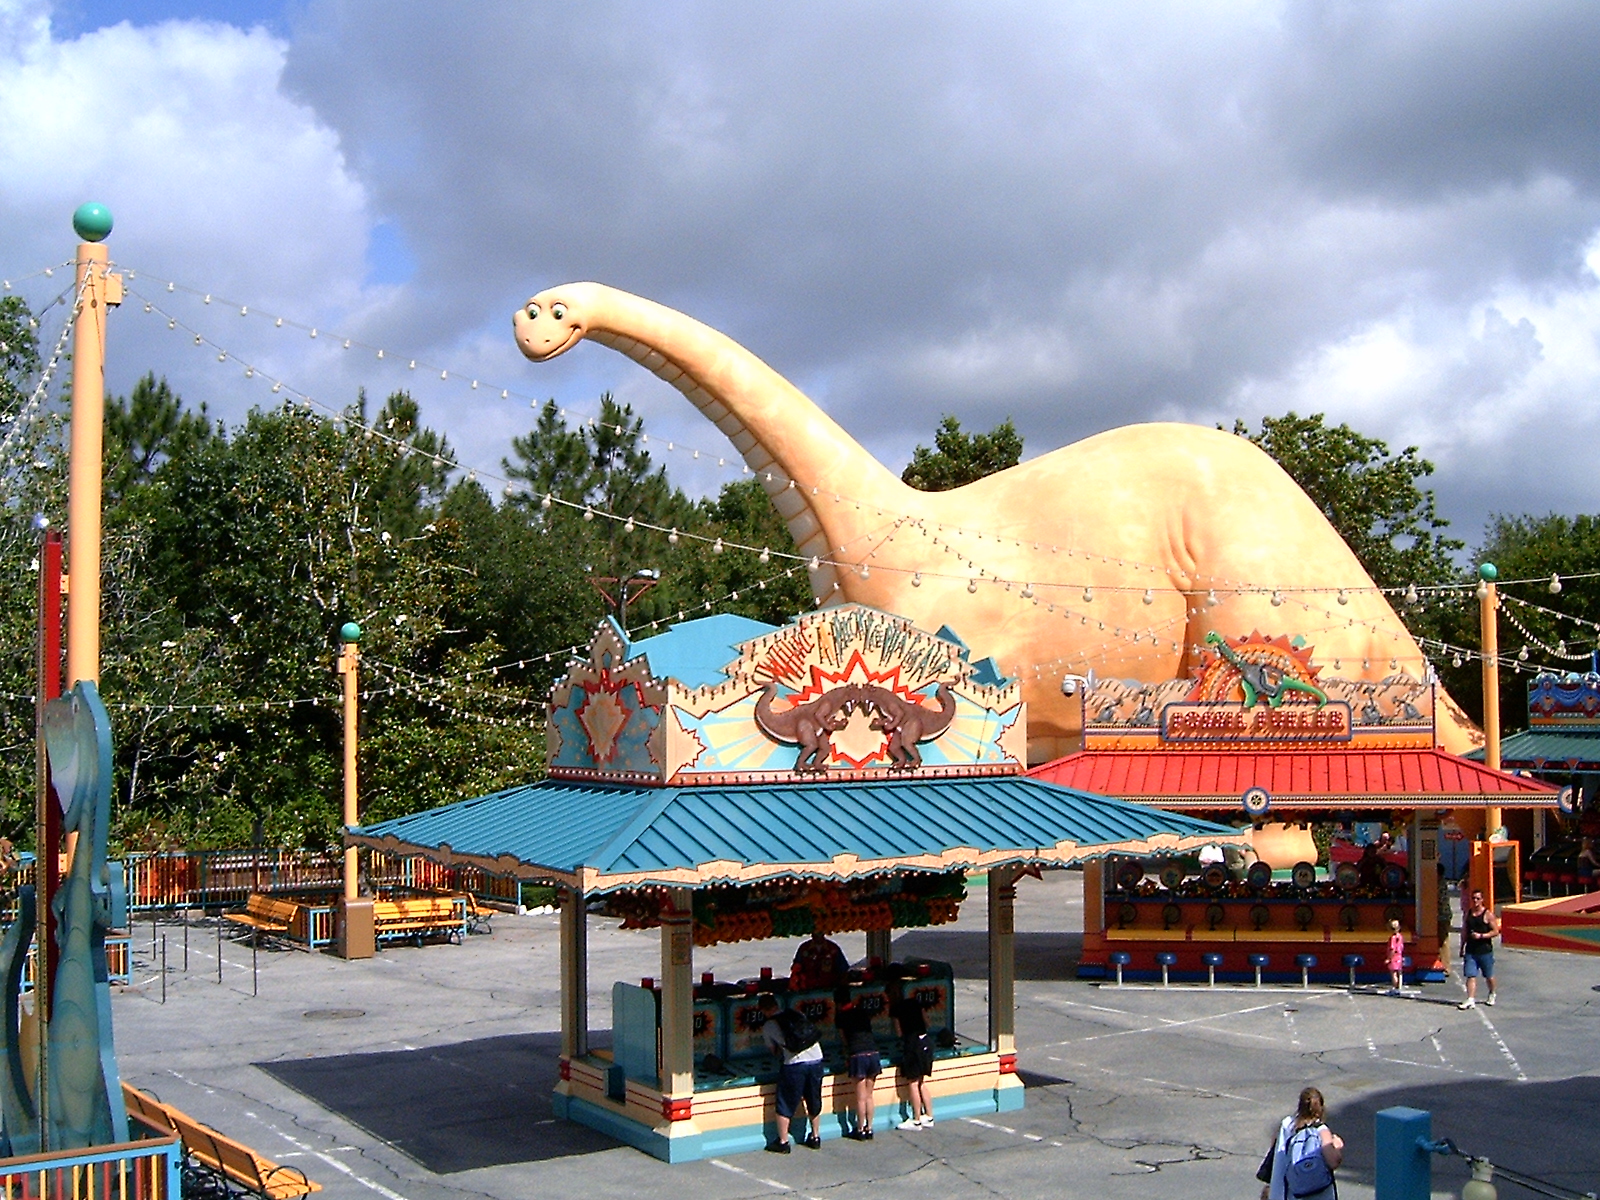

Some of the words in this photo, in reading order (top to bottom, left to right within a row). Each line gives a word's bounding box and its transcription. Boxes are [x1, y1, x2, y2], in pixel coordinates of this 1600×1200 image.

[1172, 711, 1247, 729] FOSSIL
[1257, 711, 1343, 729] FUELER
[746, 1011, 764, 1023] 130
